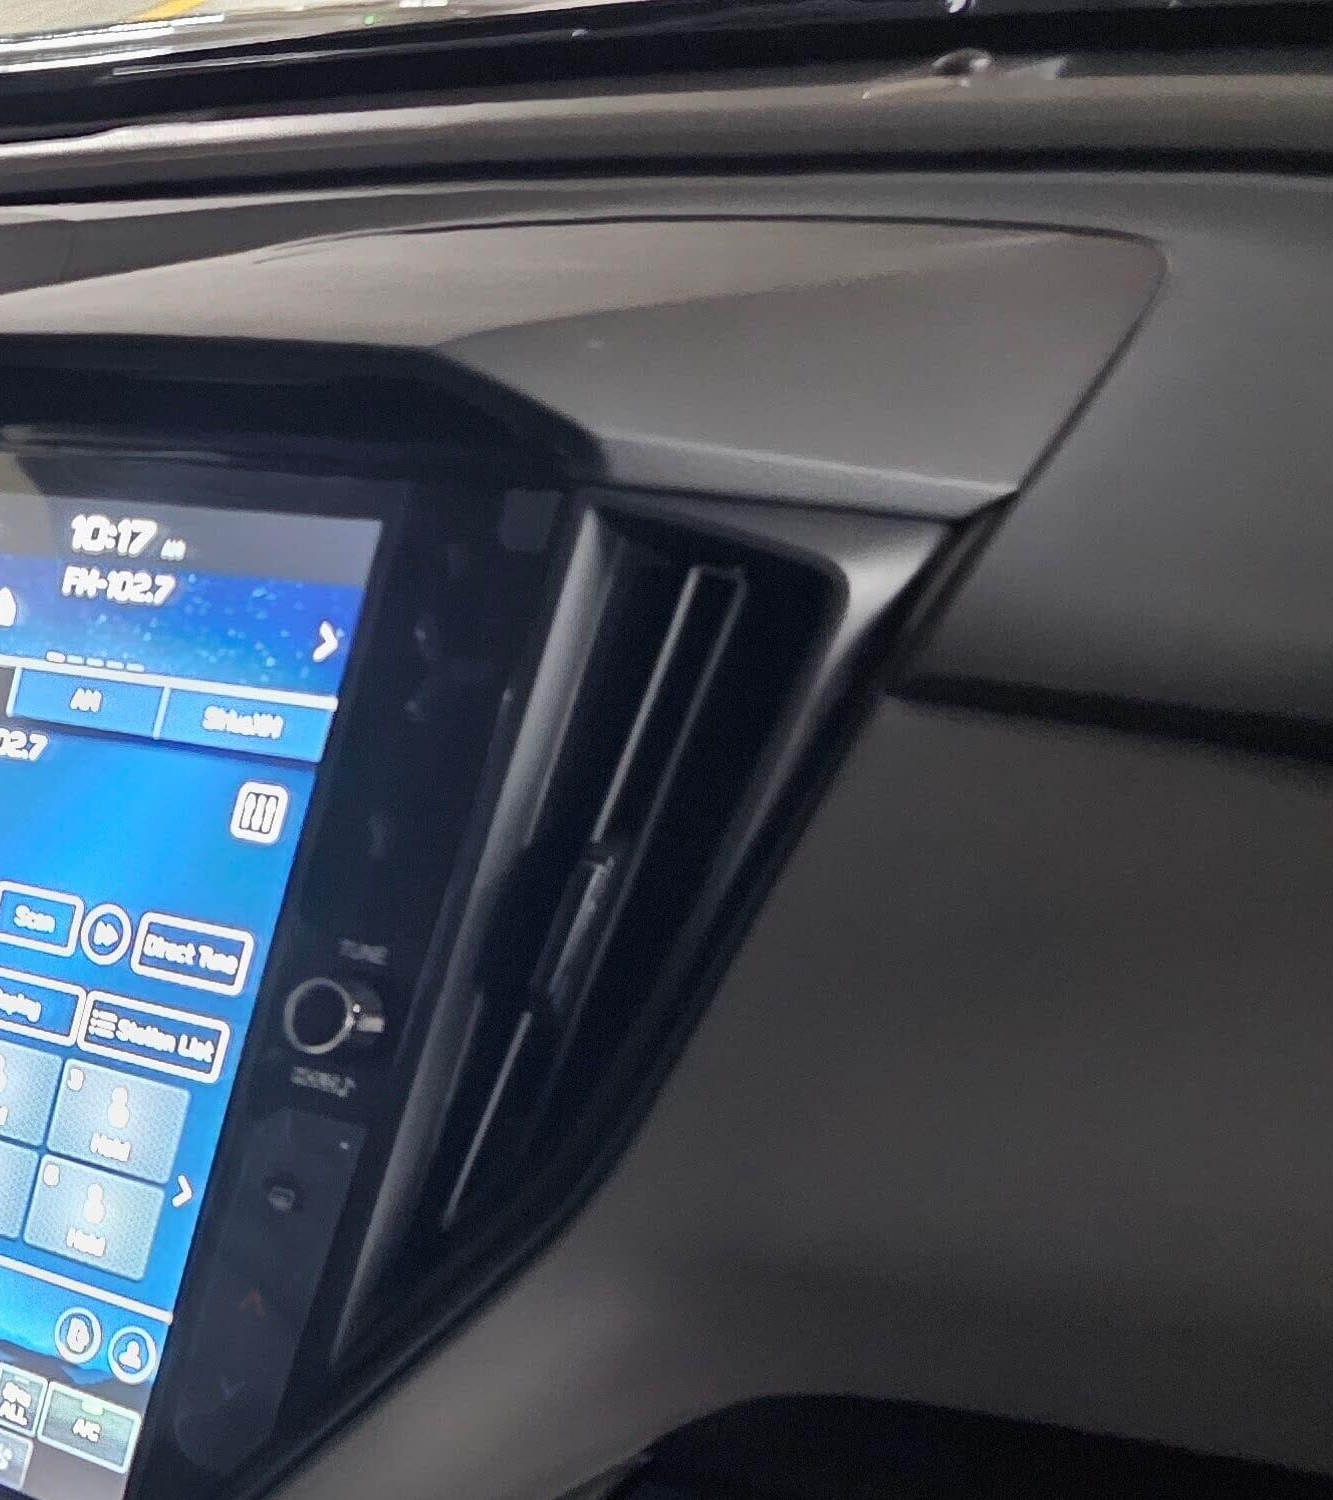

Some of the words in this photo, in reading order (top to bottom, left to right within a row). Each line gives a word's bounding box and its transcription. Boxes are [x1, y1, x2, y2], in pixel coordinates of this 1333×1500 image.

[71, 514, 158, 556] 10:17
[69, 687, 102, 713] AM
[13, 904, 57, 934] Scan
[143, 933, 195, 967] Direct
[197, 943, 239, 976] Tune
[115, 1014, 176, 1053] Station
[177, 1033, 216, 1064] List
[72, 1418, 102, 1443] A/C
